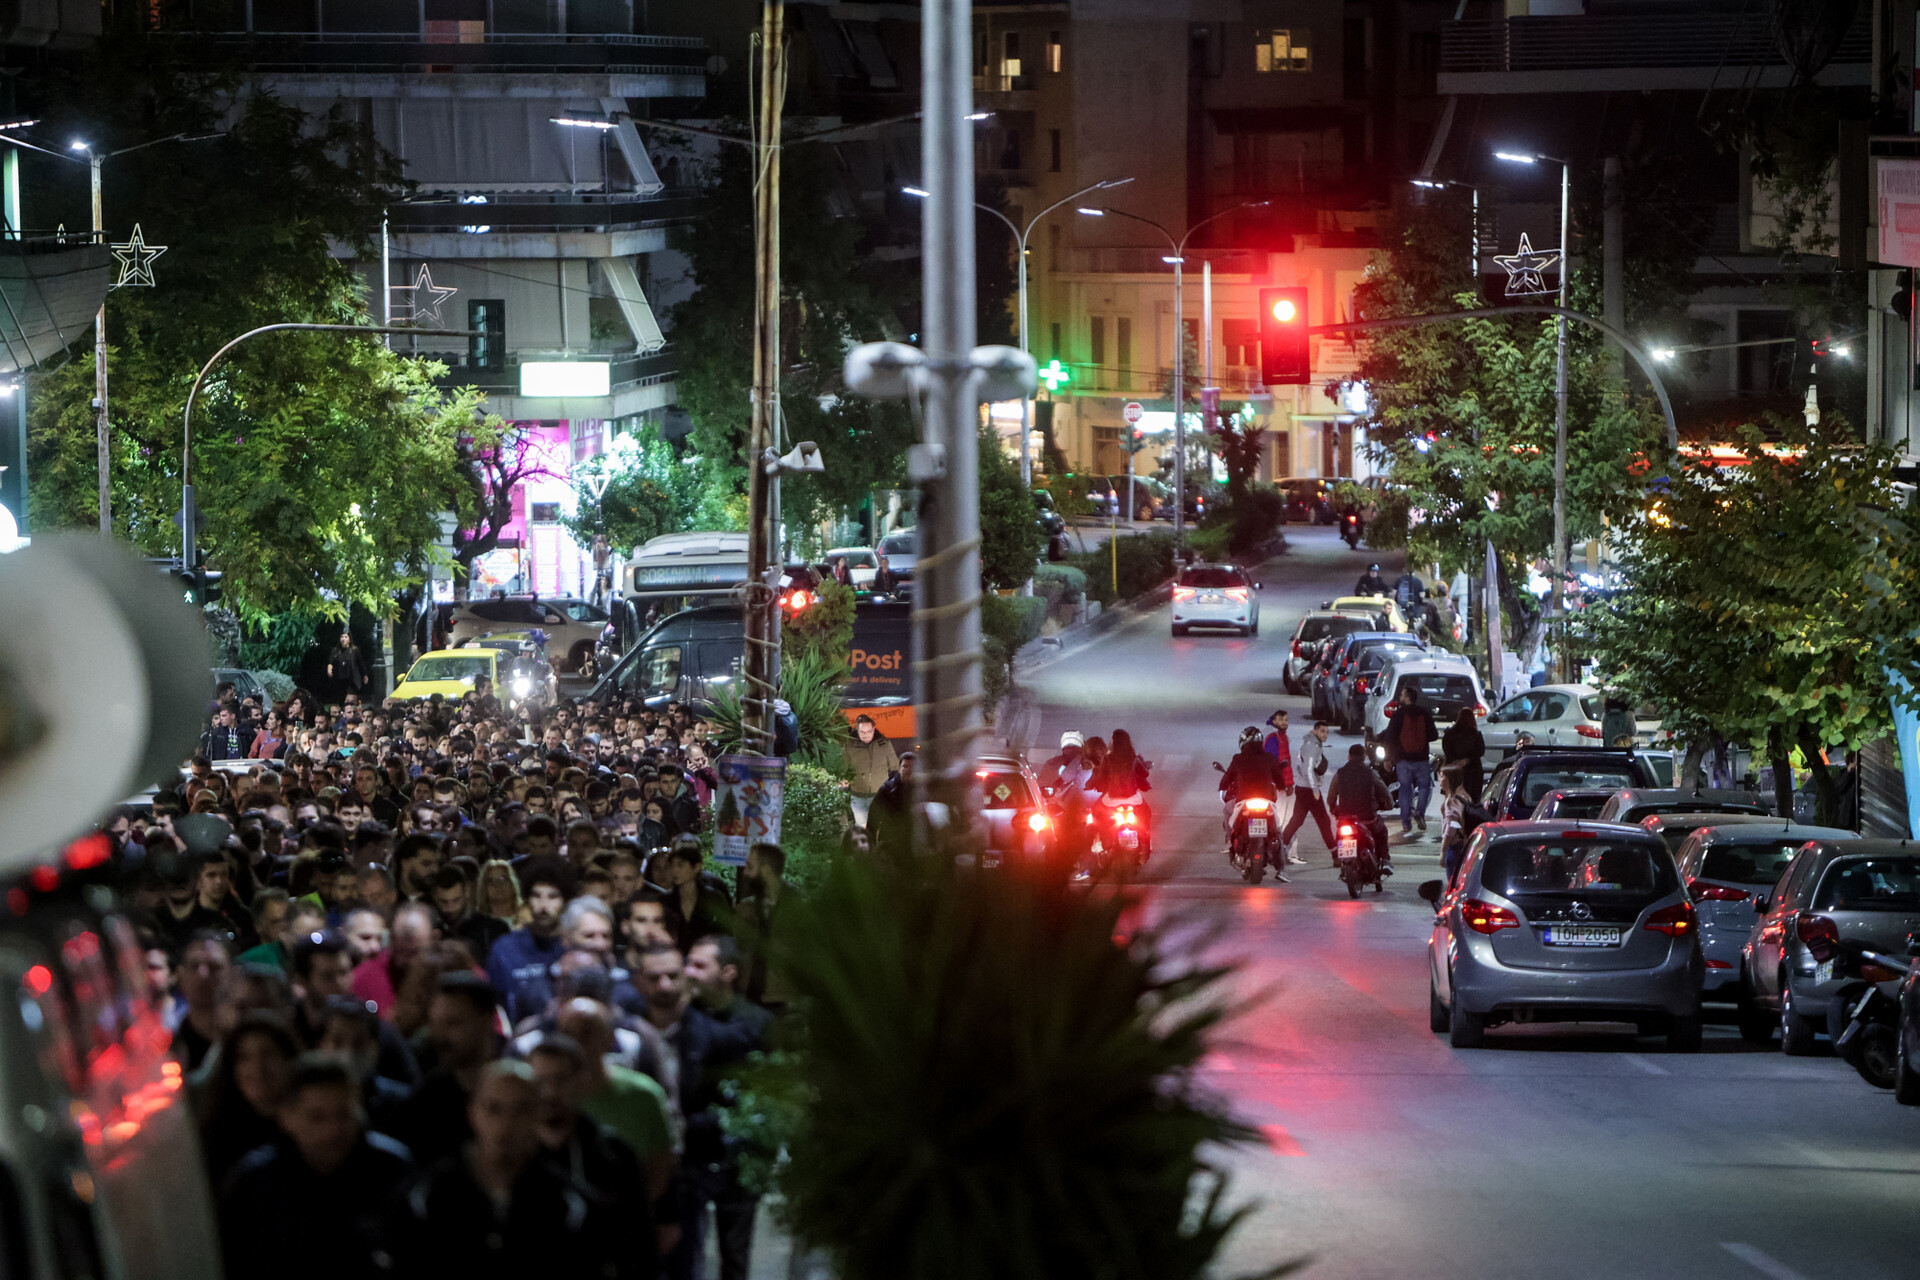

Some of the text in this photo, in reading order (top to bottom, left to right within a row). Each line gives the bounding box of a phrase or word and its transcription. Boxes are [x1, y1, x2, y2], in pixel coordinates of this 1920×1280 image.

[1125, 407, 1143, 418] STOP
[639, 568, 665, 583] 608
[869, 675, 902, 686] delivery
